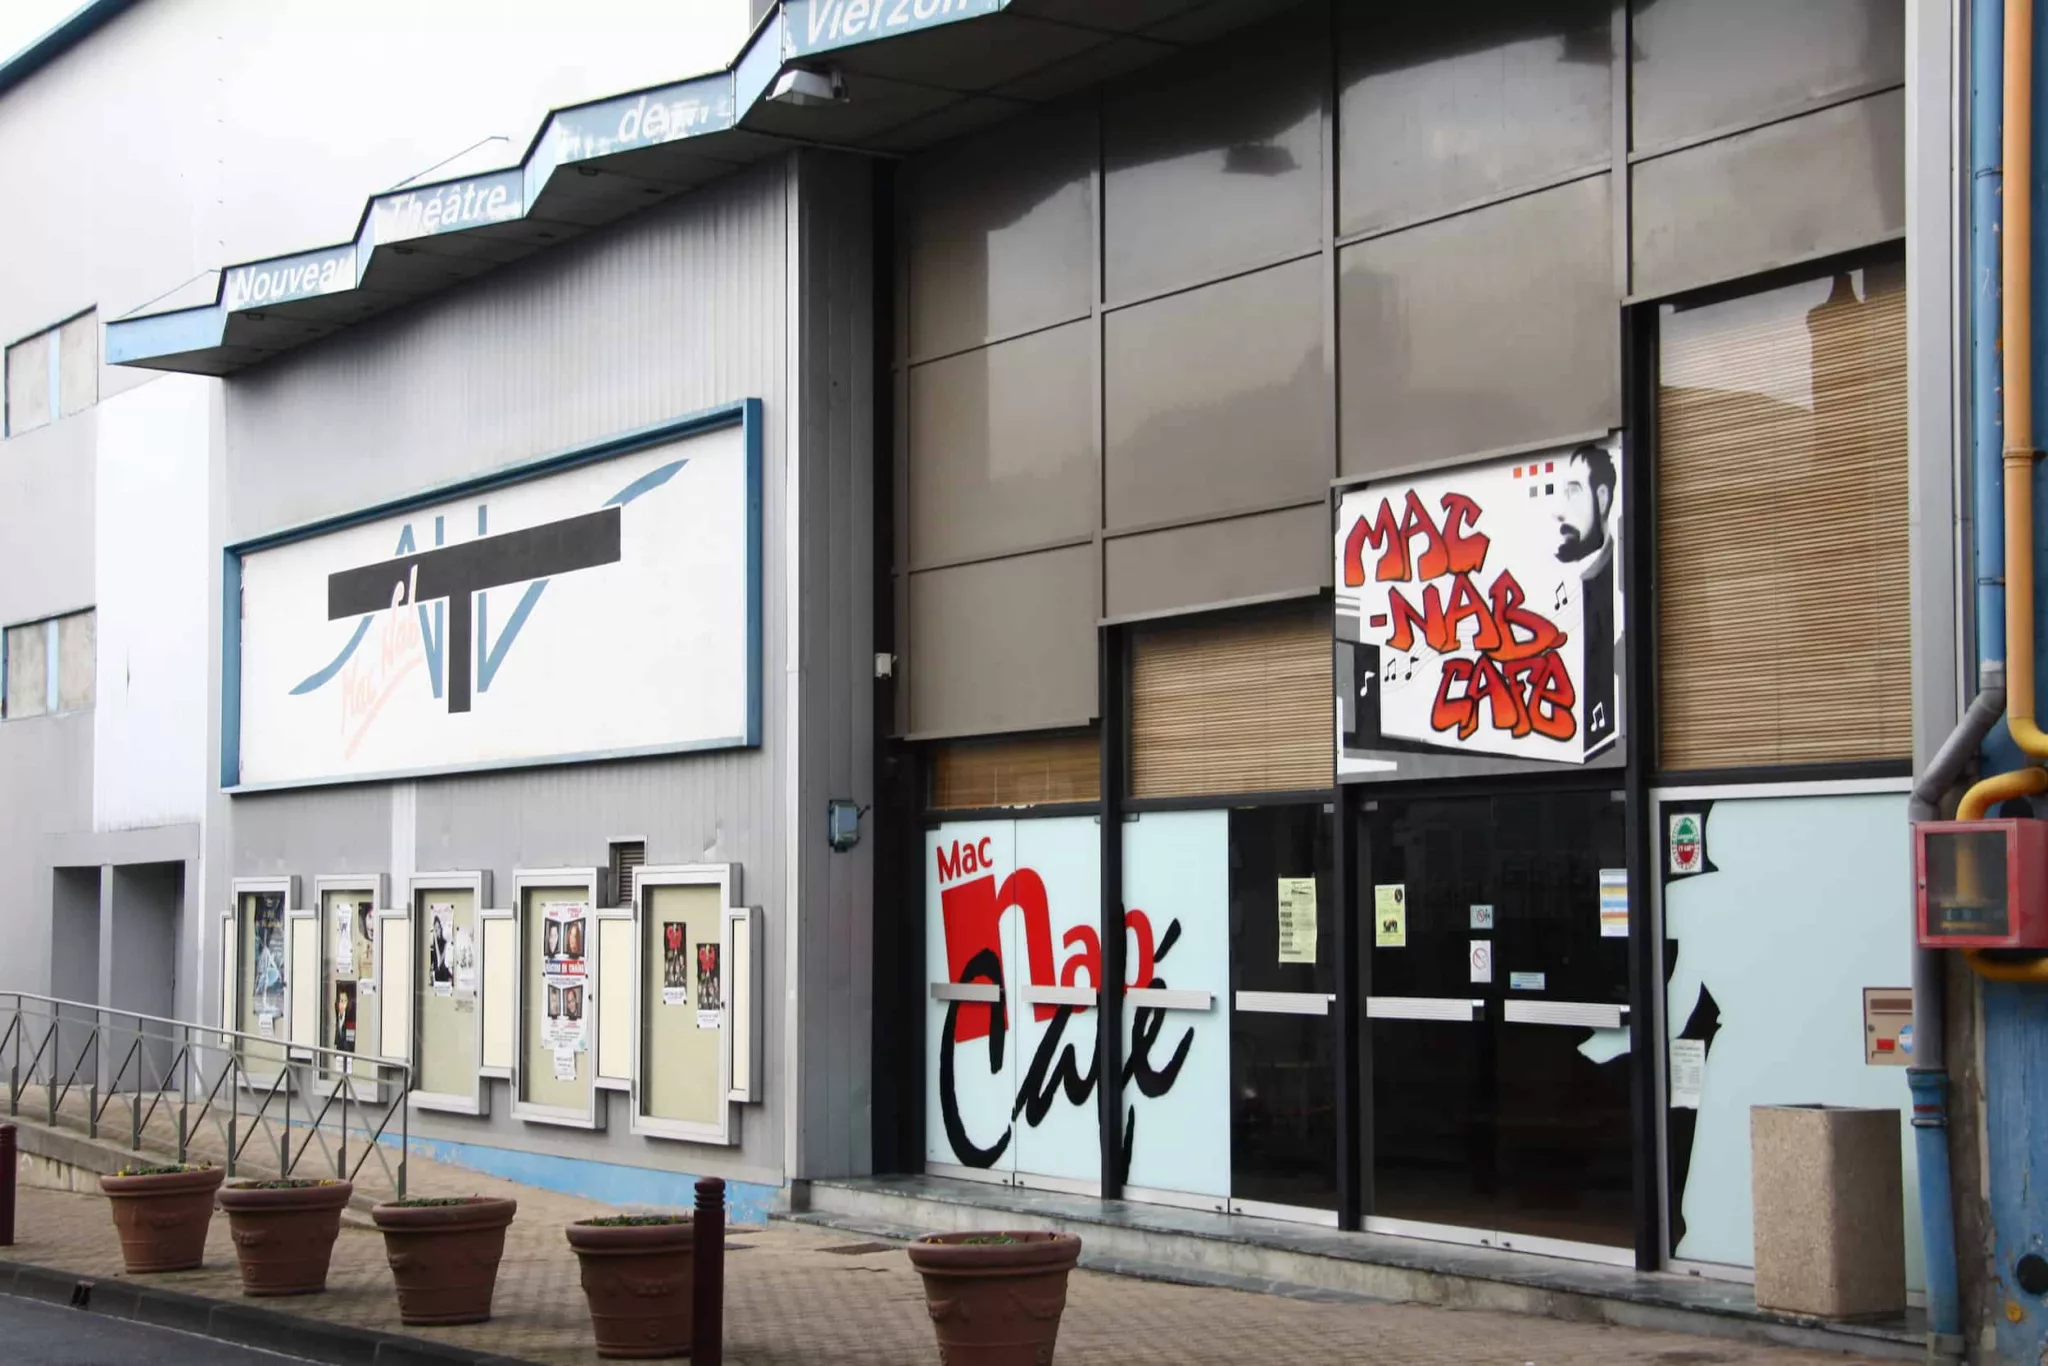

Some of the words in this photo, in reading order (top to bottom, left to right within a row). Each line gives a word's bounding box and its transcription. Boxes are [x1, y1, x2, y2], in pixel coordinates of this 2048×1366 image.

[389, 182, 508, 233] Théâtre
[1344, 488, 1490, 588] MAC
[936, 836, 993, 883] Mac
